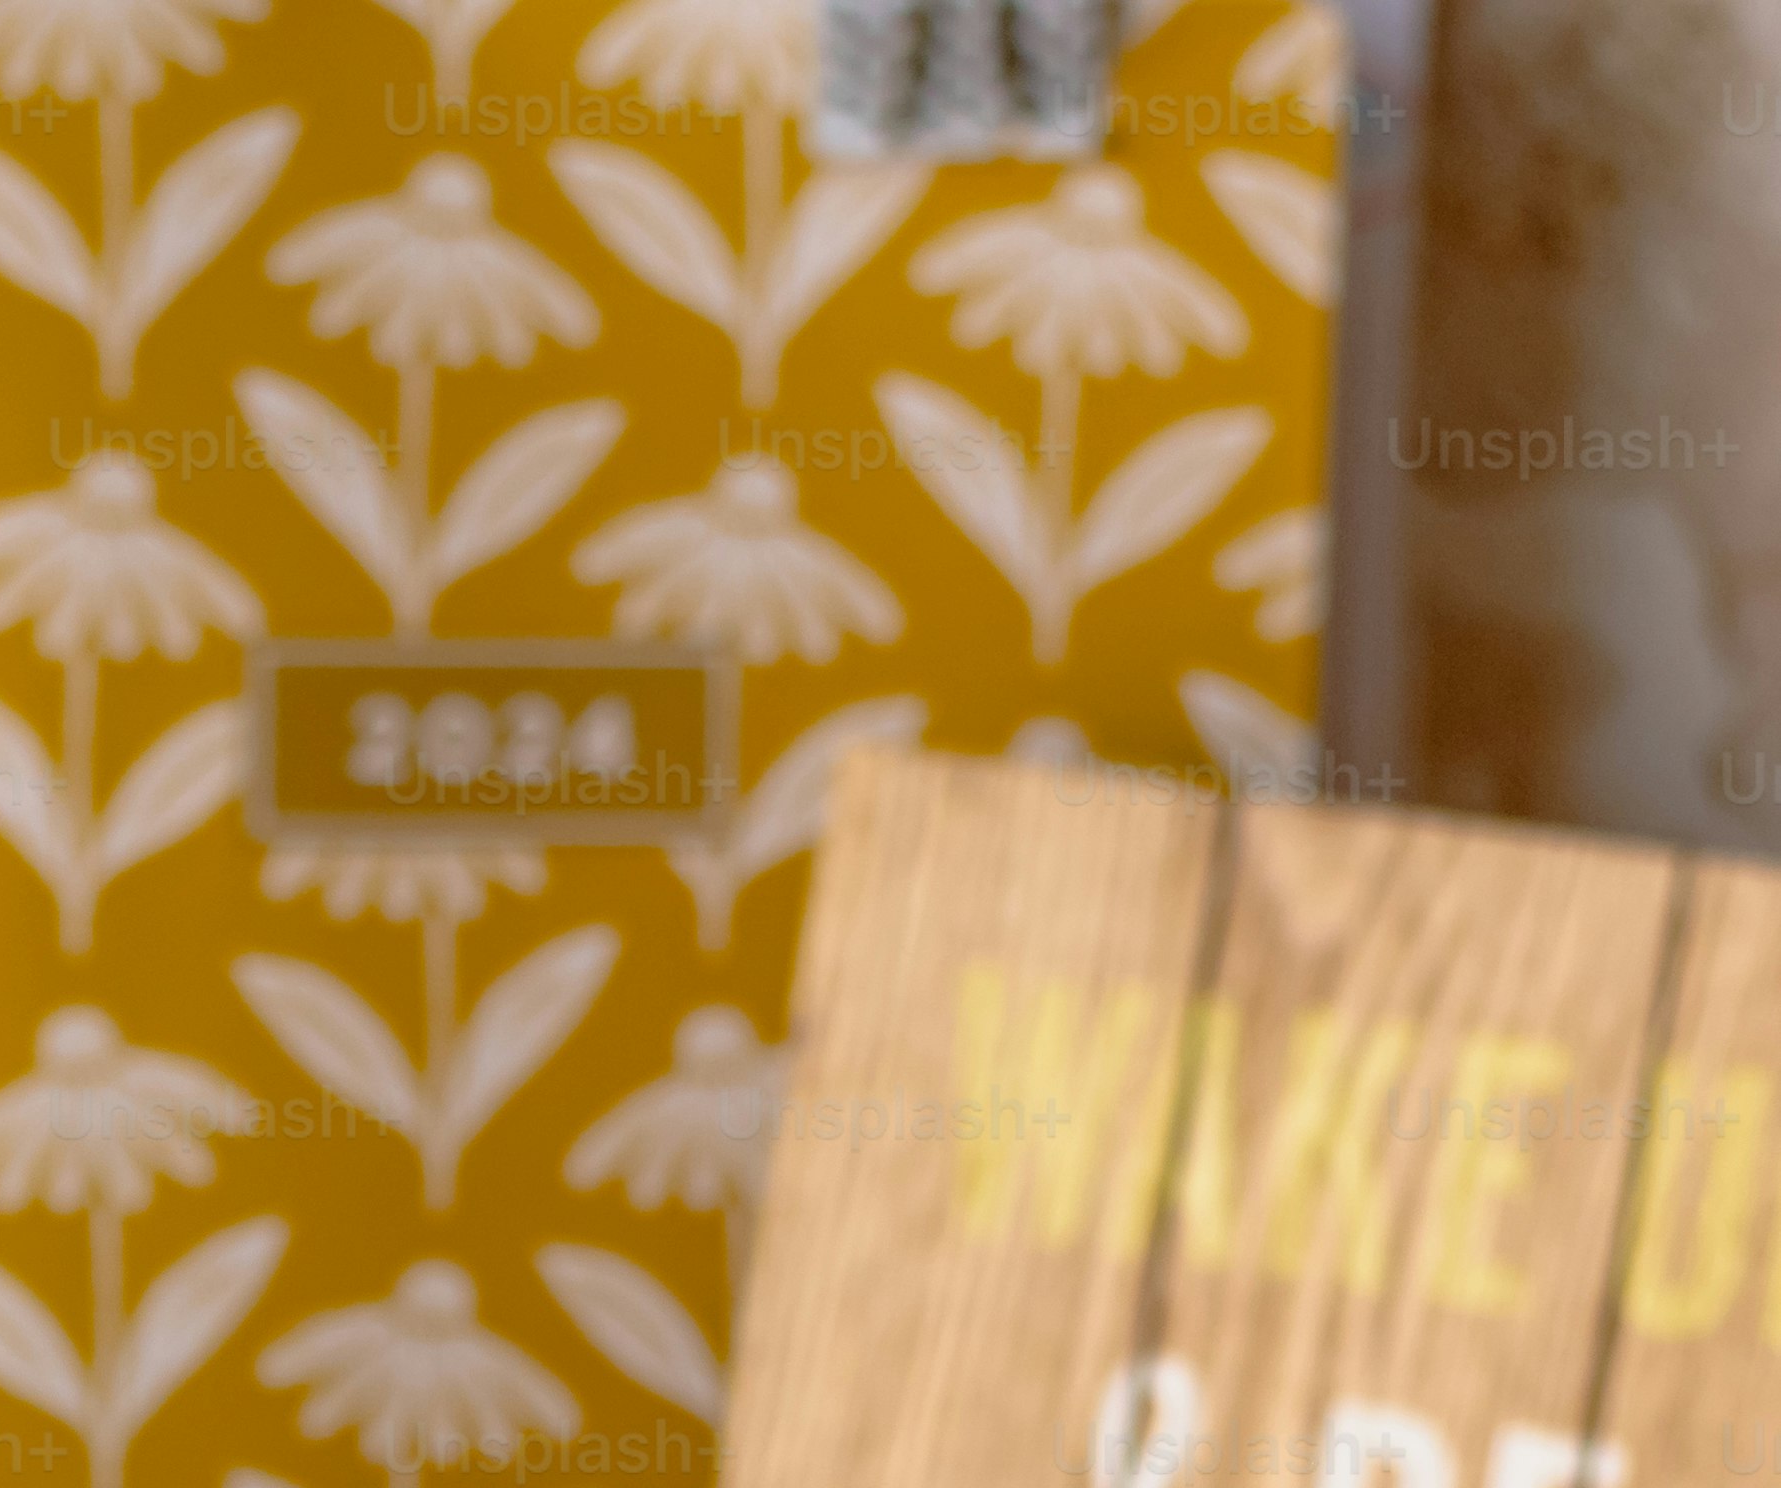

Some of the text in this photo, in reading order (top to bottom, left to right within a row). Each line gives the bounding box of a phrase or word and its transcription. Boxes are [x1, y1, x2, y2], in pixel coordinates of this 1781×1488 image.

[349, 690, 639, 786] 2024
[955, 955, 1781, 1368] WAKE U
